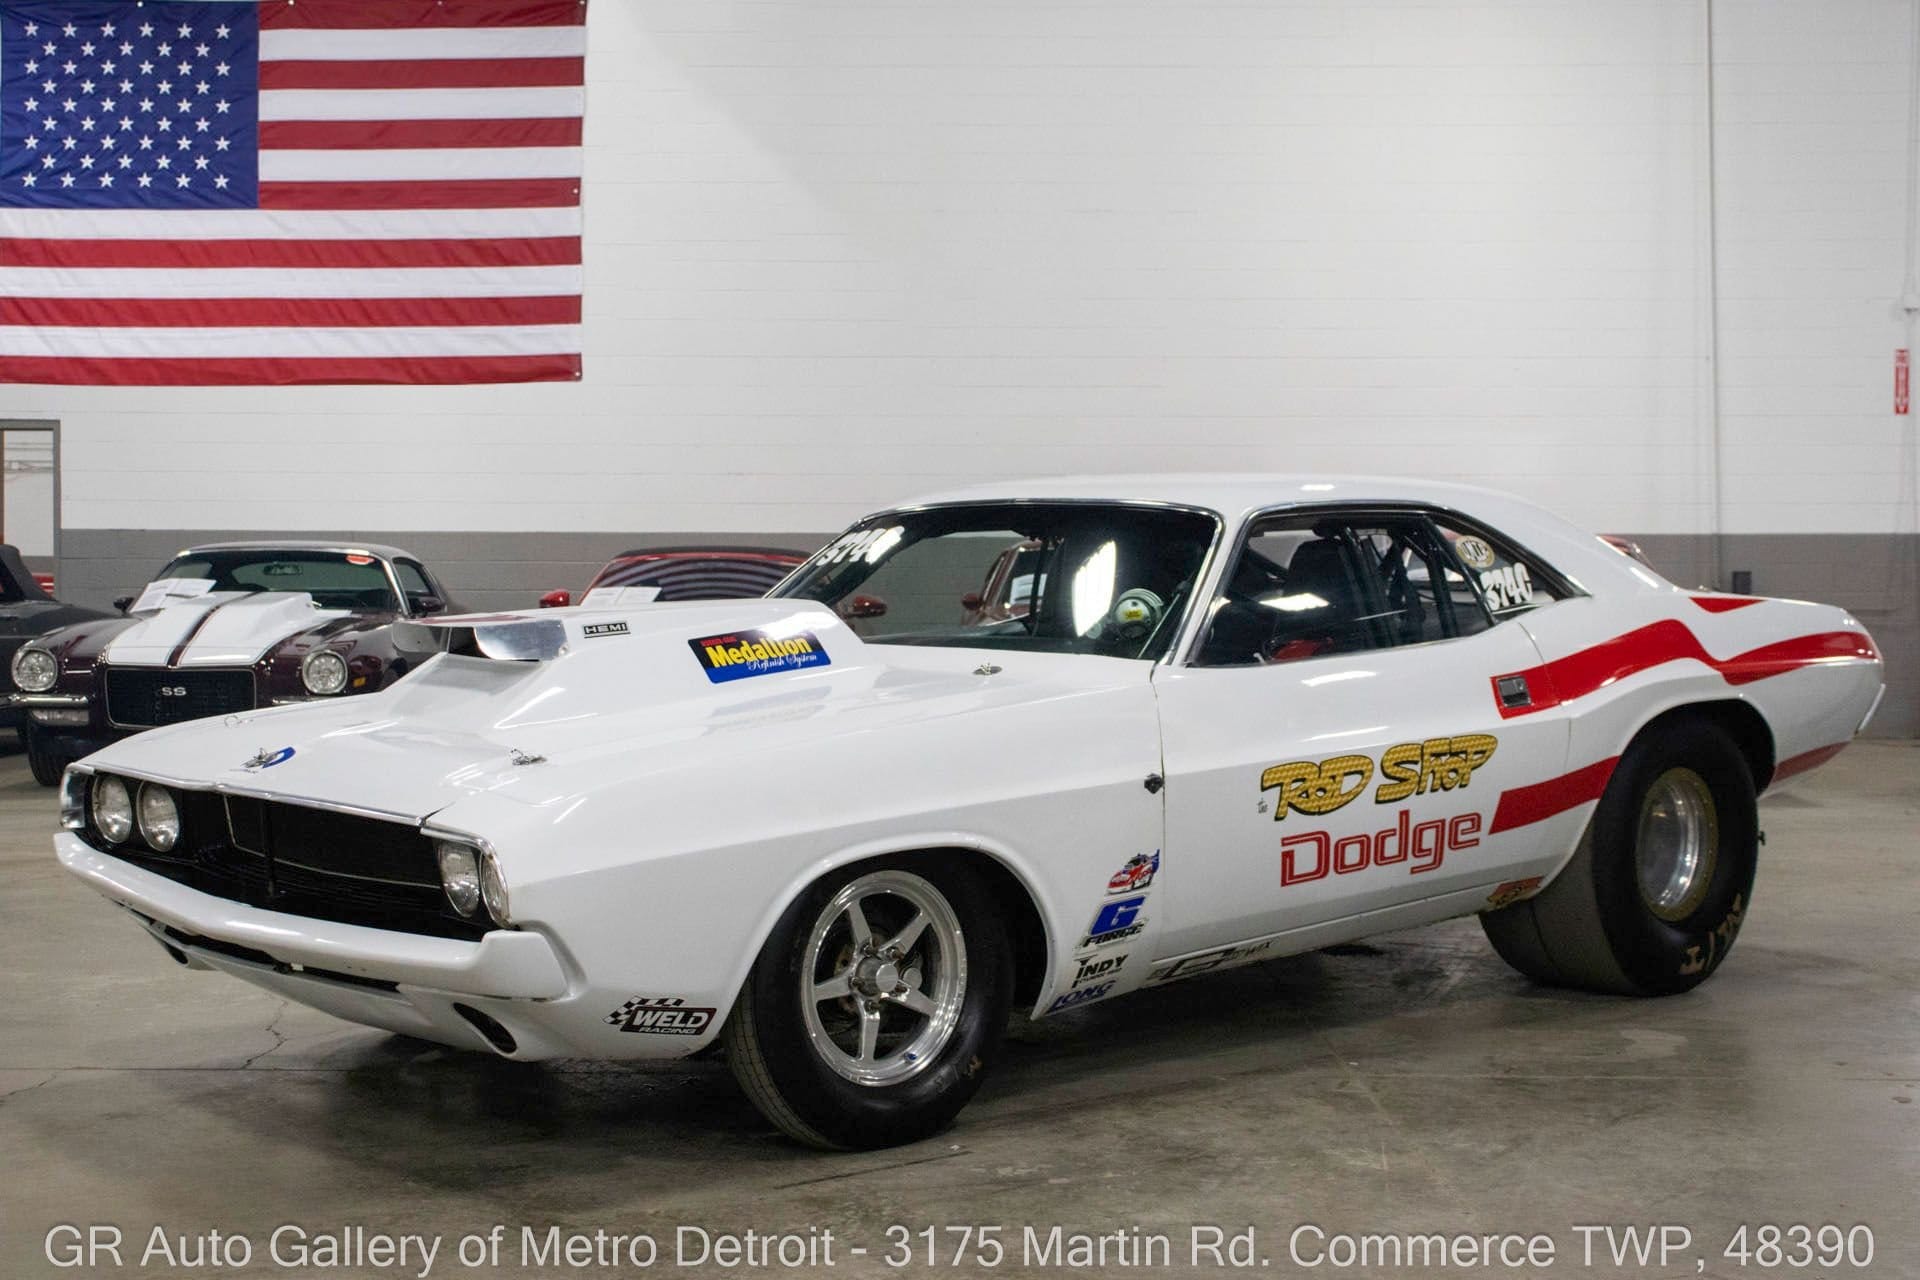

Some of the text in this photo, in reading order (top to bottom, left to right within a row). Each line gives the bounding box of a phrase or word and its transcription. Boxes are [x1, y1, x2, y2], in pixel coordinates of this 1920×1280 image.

[584, 622, 628, 634] HEMI
[704, 637, 813, 668] Medallion
[161, 686, 187, 697] SS
[1261, 734, 1498, 822] ROD SHOP
[1280, 809, 1482, 887] Dodge
[1071, 953, 1129, 989] INDY
[631, 1010, 710, 1028] WELD
[638, 1026, 698, 1035] RACING
